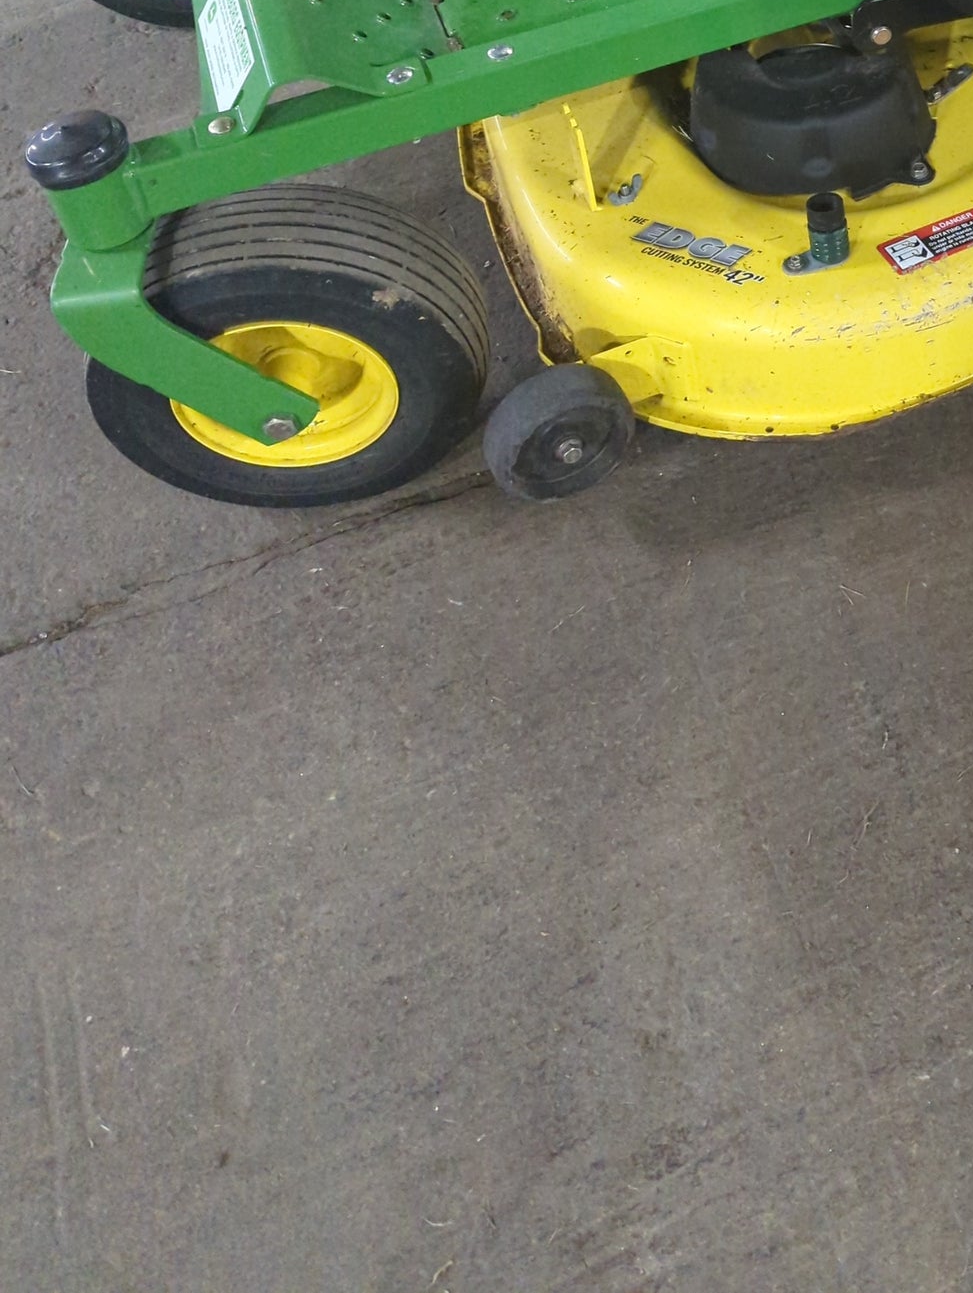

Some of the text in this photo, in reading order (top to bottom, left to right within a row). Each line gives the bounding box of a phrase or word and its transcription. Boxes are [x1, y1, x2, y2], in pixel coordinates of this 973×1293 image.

[628, 215, 650, 226] THE
[938, 212, 973, 228] DANGER
[929, 225, 962, 240] ROTATING
[630, 221, 753, 267] EDGE
[641, 246, 766, 286] CUTTING SYSTEM 42"
